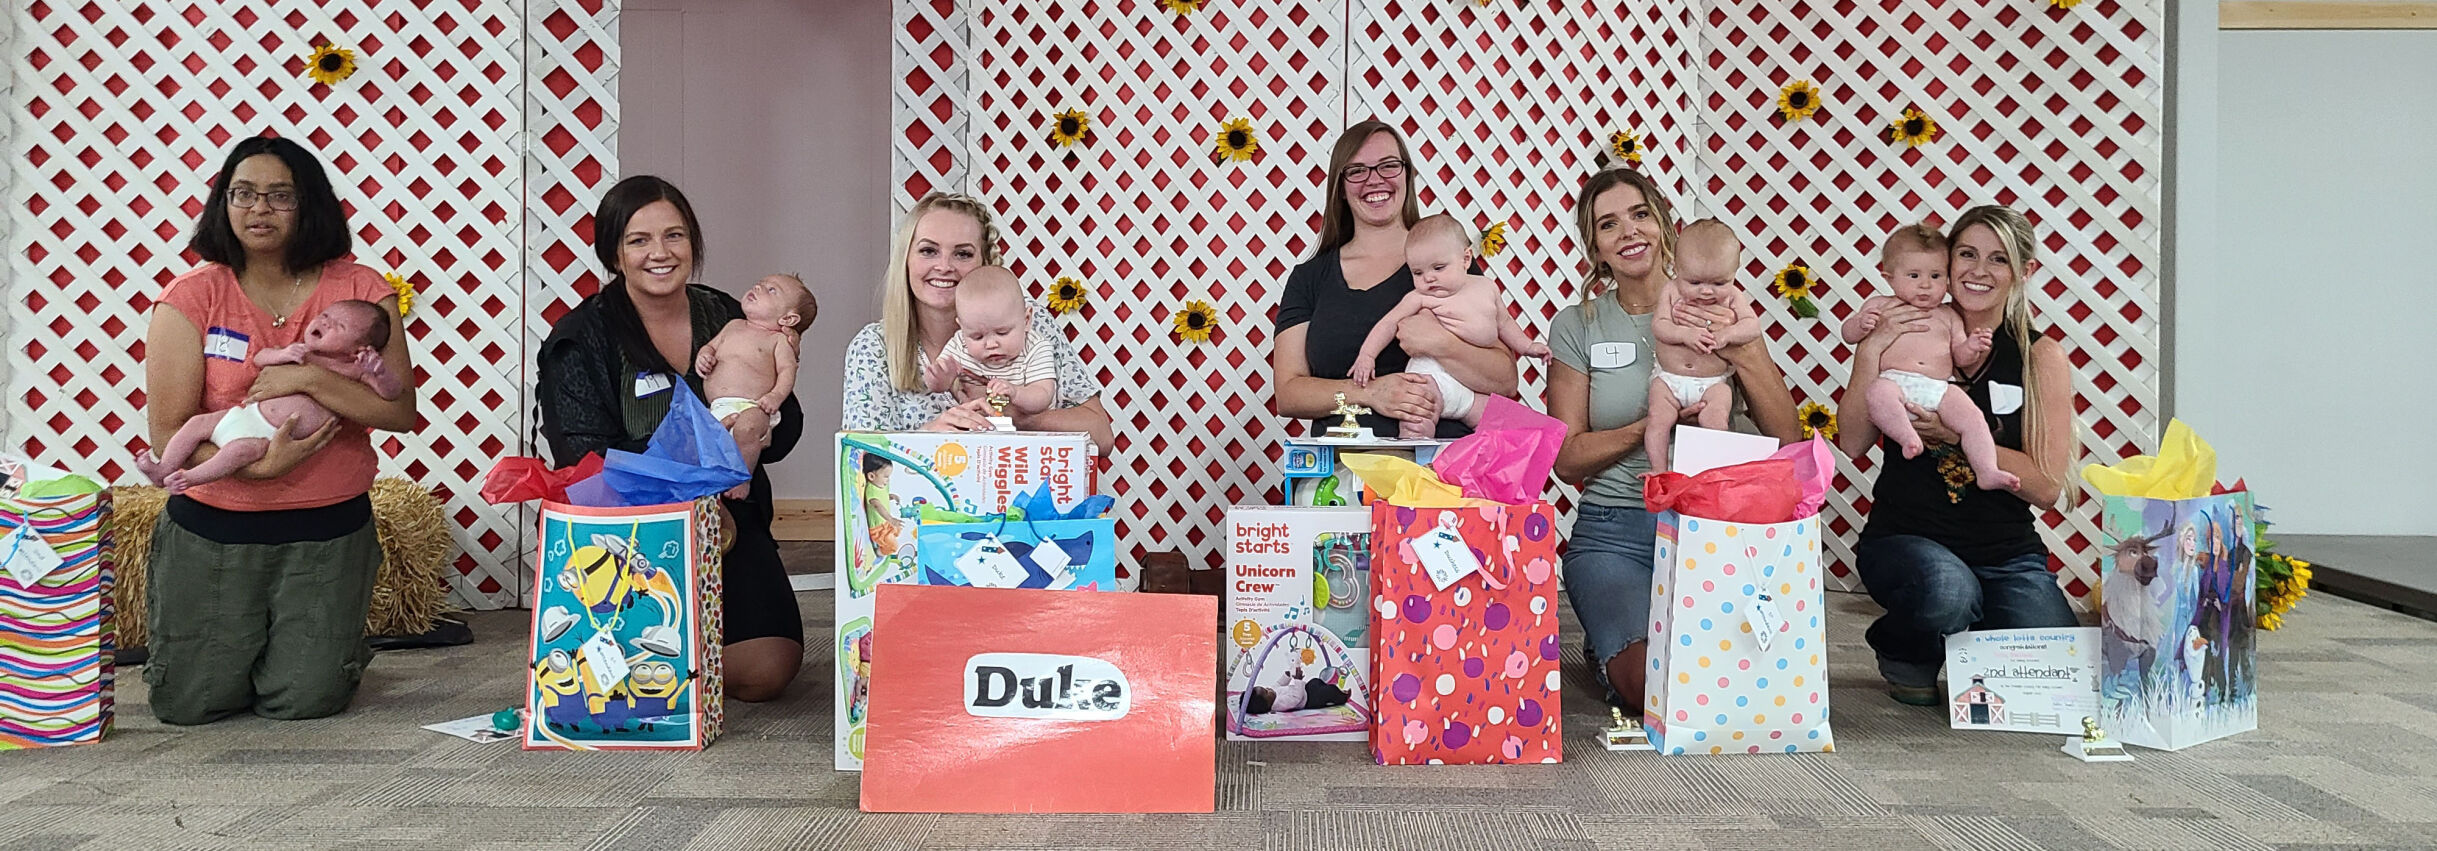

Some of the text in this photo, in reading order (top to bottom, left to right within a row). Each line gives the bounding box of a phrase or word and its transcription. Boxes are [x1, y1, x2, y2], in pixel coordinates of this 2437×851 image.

[1605, 345, 1620, 365] 4
[1014, 446, 1028, 485] Wild
[994, 446, 1011, 512] Wiggles
[1053, 446, 1073, 505] bright
[1236, 522, 1290, 542] bright
[1235, 539, 1290, 554] starts
[1235, 564, 1296, 578] Unicorn
[1235, 580, 1275, 593] Crew
[1243, 621, 1251, 632] 5
[1984, 634, 2010, 642] whole
[2039, 633, 2076, 643] country
[1983, 664, 2071, 679] 2nd attendant
[971, 663, 1123, 712] Duke
